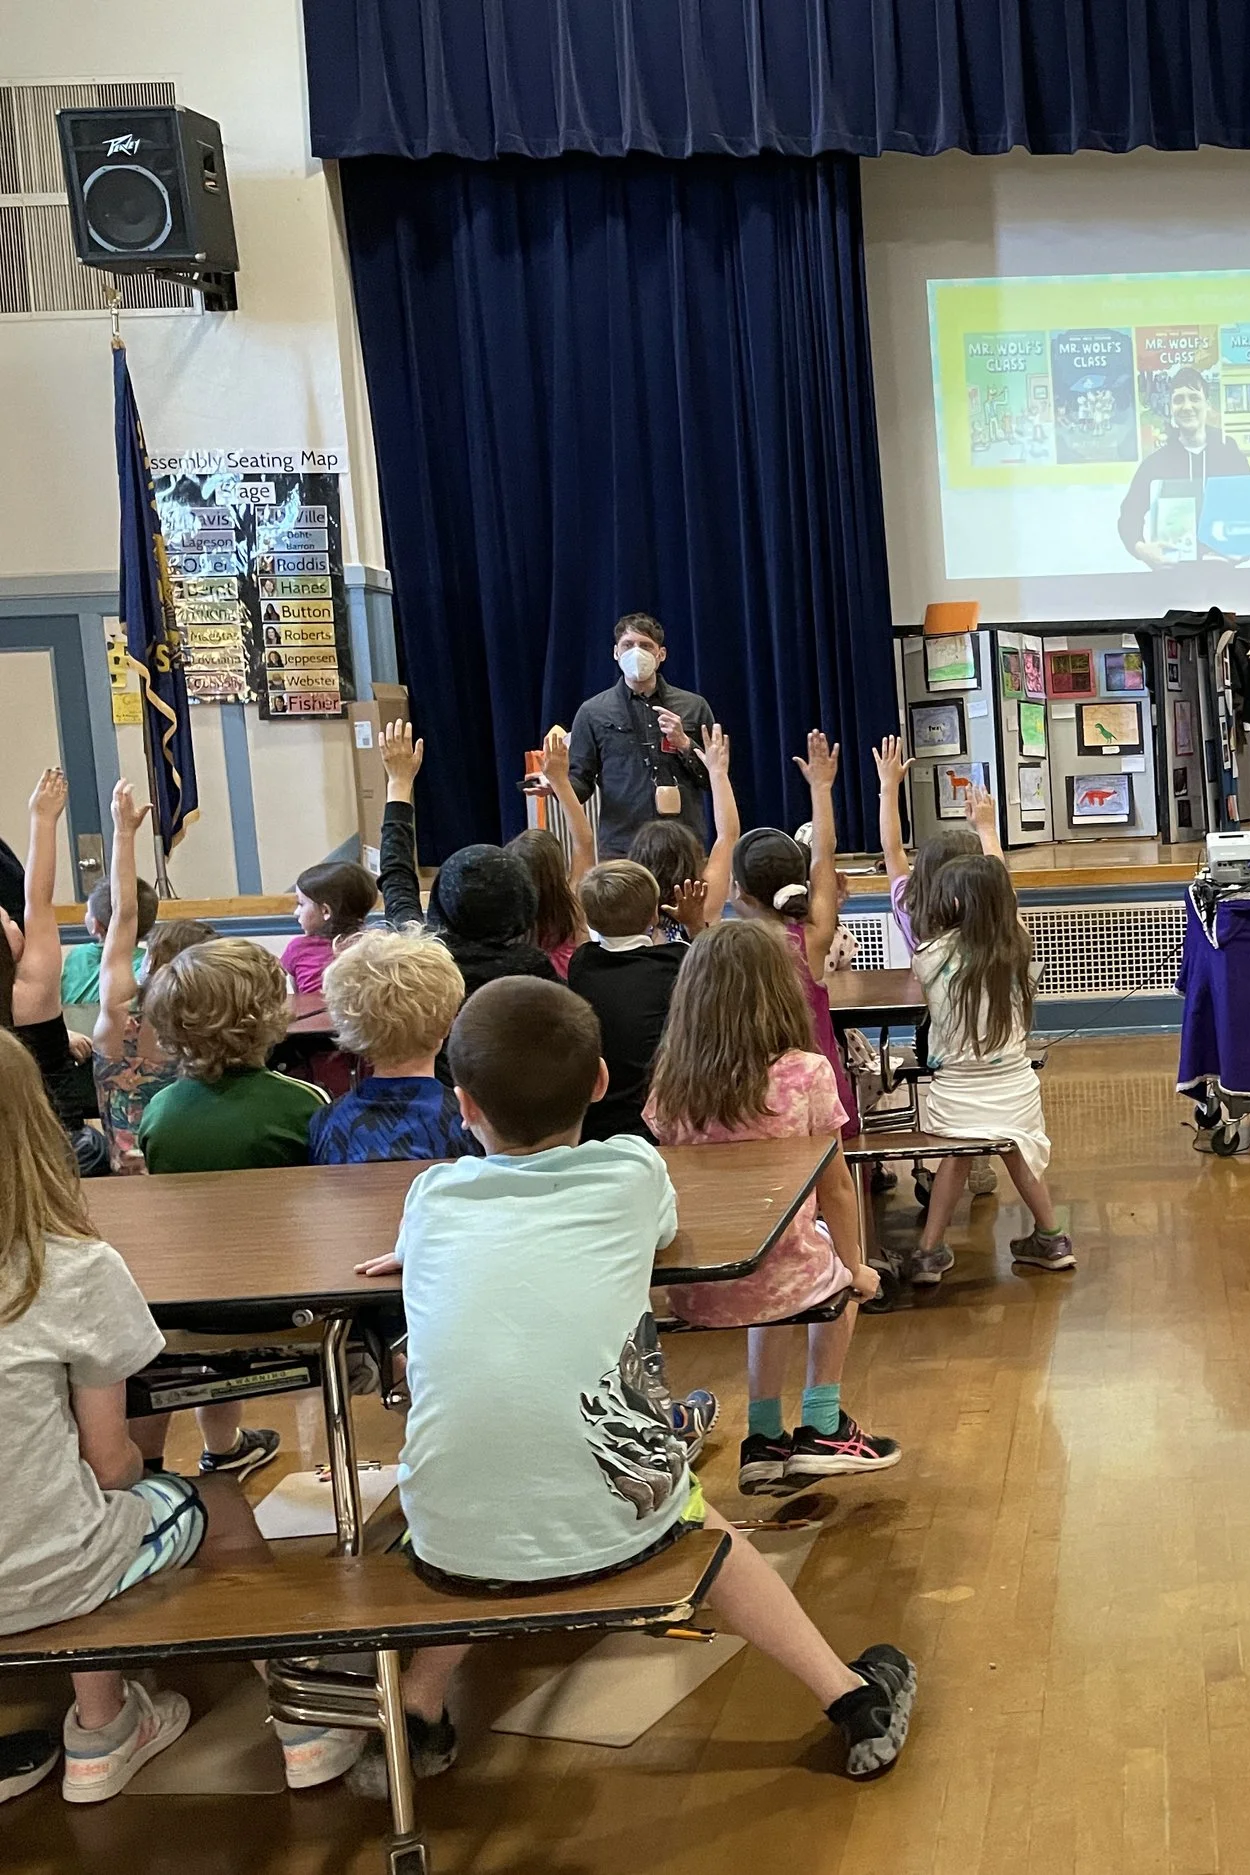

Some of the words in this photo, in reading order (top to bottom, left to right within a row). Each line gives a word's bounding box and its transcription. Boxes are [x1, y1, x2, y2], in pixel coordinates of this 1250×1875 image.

[968, 342, 994, 356] MR.
[999, 340, 1044, 355] WOLF'S
[1059, 343, 1080, 354] MR.
[1082, 341, 1122, 353] WOLF'S
[1145, 338, 1166, 349] MR.
[1169, 336, 1209, 349] WOLF'S
[1073, 356, 1107, 368] CLASS
[1160, 352, 1194, 364] CLASS
[986, 358, 1026, 372] CLASS
[150, 452, 222, 471] ssembly
[227, 452, 294, 472] Seating
[301, 450, 338, 470] Map
[277, 557, 327, 572] Roddis
[281, 581, 327, 595] Hanes
[282, 605, 331, 619] Button
[284, 629, 332, 641] Roberts
[284, 653, 336, 666] Jeppesen
[287, 675, 336, 687] Webster
[289, 695, 339, 710] Fisher
